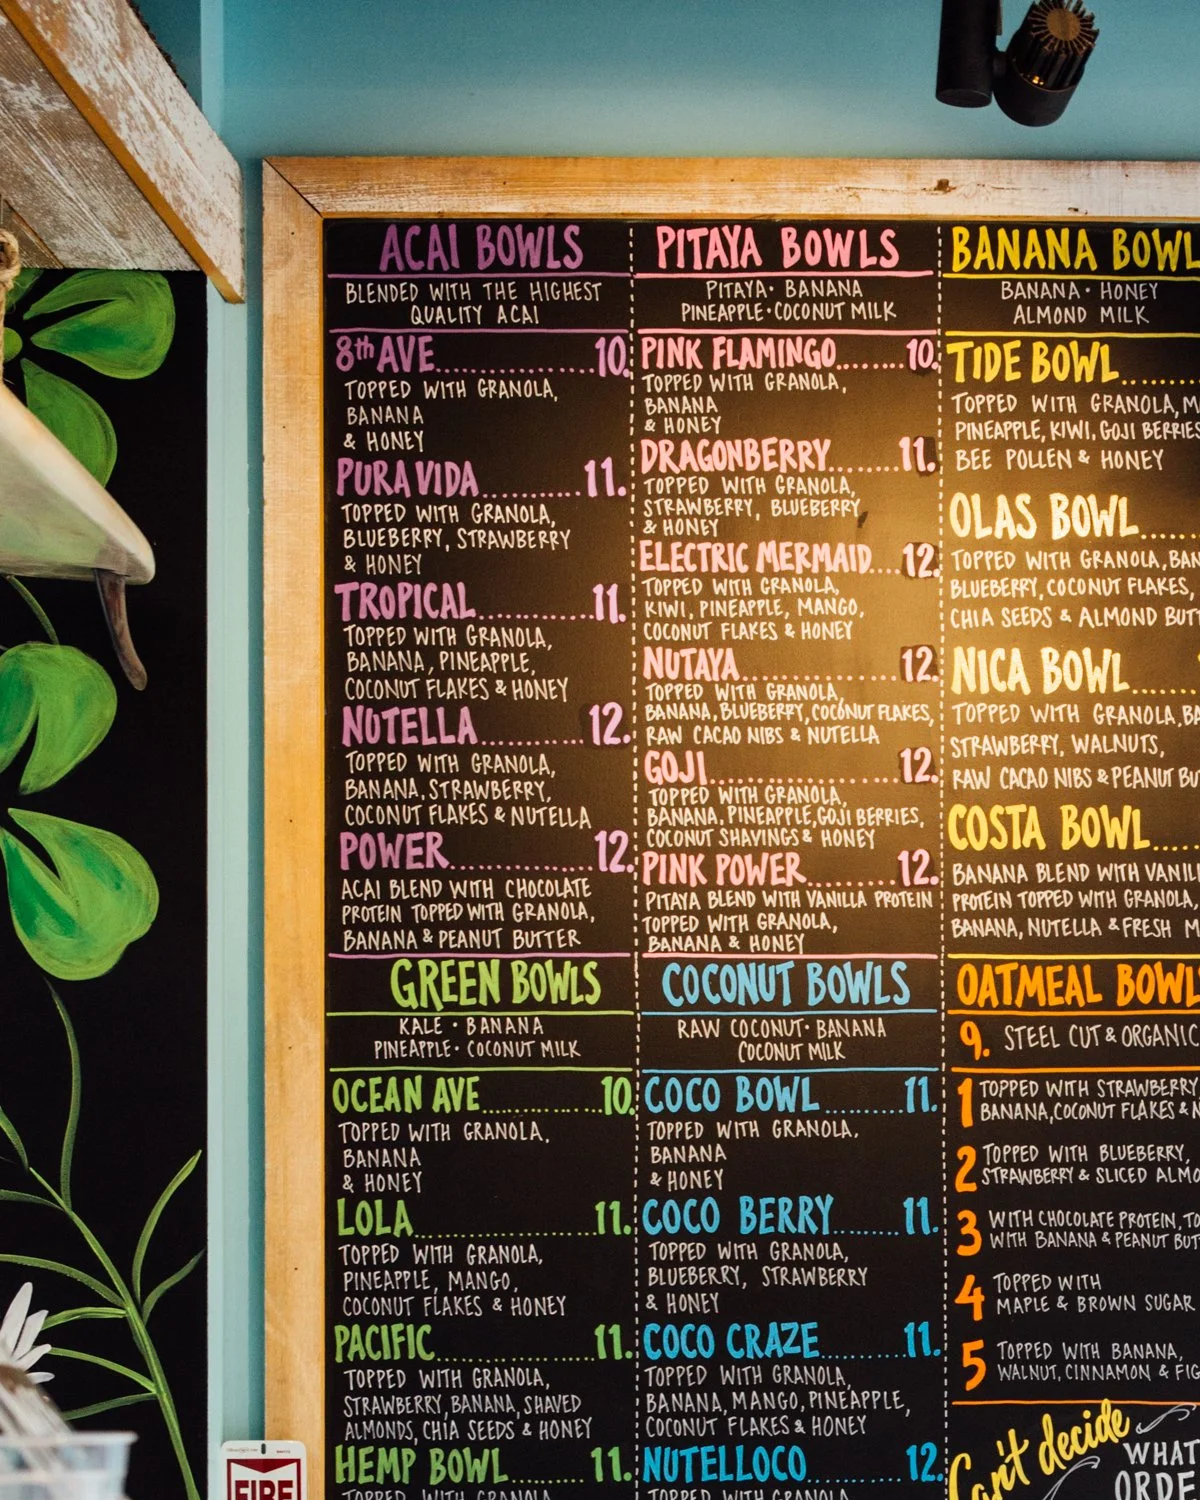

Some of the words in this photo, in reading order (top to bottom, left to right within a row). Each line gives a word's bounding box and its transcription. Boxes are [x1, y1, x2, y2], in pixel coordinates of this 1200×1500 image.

[378, 226, 460, 273] ACAI
[477, 226, 584, 271] BOWLS
[657, 226, 763, 271] PITAYA
[782, 228, 900, 269] BOWLS
[951, 226, 1098, 273] BANANA
[345, 281, 419, 305] BLENDED
[429, 282, 472, 302] WITH
[482, 281, 518, 301] THE
[529, 281, 603, 302] HIGHEST
[410, 304, 483, 326] QUALITY
[497, 304, 540, 325] ACAI
[336, 334, 375, 372] 8th
[376, 334, 435, 374] AVE
[945, 339, 1022, 383] TIDE
[1031, 340, 1120, 384] BOWL
[640, 436, 835, 475] DRAGONBERRY
[343, 704, 479, 747] NUTELLA
[345, 804, 423, 826] COCONUT
[428, 802, 489, 826] FLAKES
[494, 805, 506, 823] &
[511, 805, 592, 830] NUTELLA
[645, 891, 701, 912] PITAYA
[707, 889, 756, 909] BLEND
[761, 889, 801, 909] WITH
[805, 889, 868, 909] VANILLA
[873, 890, 933, 909] PROTEIN
[390, 958, 501, 1012] GREEN
[510, 958, 602, 1006] BOWLS
[661, 960, 795, 1008] COCONUT
[806, 960, 911, 1007] BOWLS
[956, 962, 1103, 1009] OATMEAL
[1004, 1024, 1061, 1051] STEEL
[1068, 1023, 1102, 1049] CUT
[1105, 1026, 1118, 1043] &
[1121, 1023, 1200, 1048] ORGANIC
[337, 1198, 414, 1238] LOLA
[954, 1274, 986, 1322] 4
[996, 1295, 1050, 1315] MAPLE
[1056, 1295, 1069, 1311] &
[1077, 1294, 1137, 1313] BROWN
[1144, 1293, 1196, 1313] SUGAR
[1036, 1398, 1131, 1474] decide
[1122, 1438, 1200, 1466] WHAT
[642, 1444, 807, 1484] NUTELLOCO
